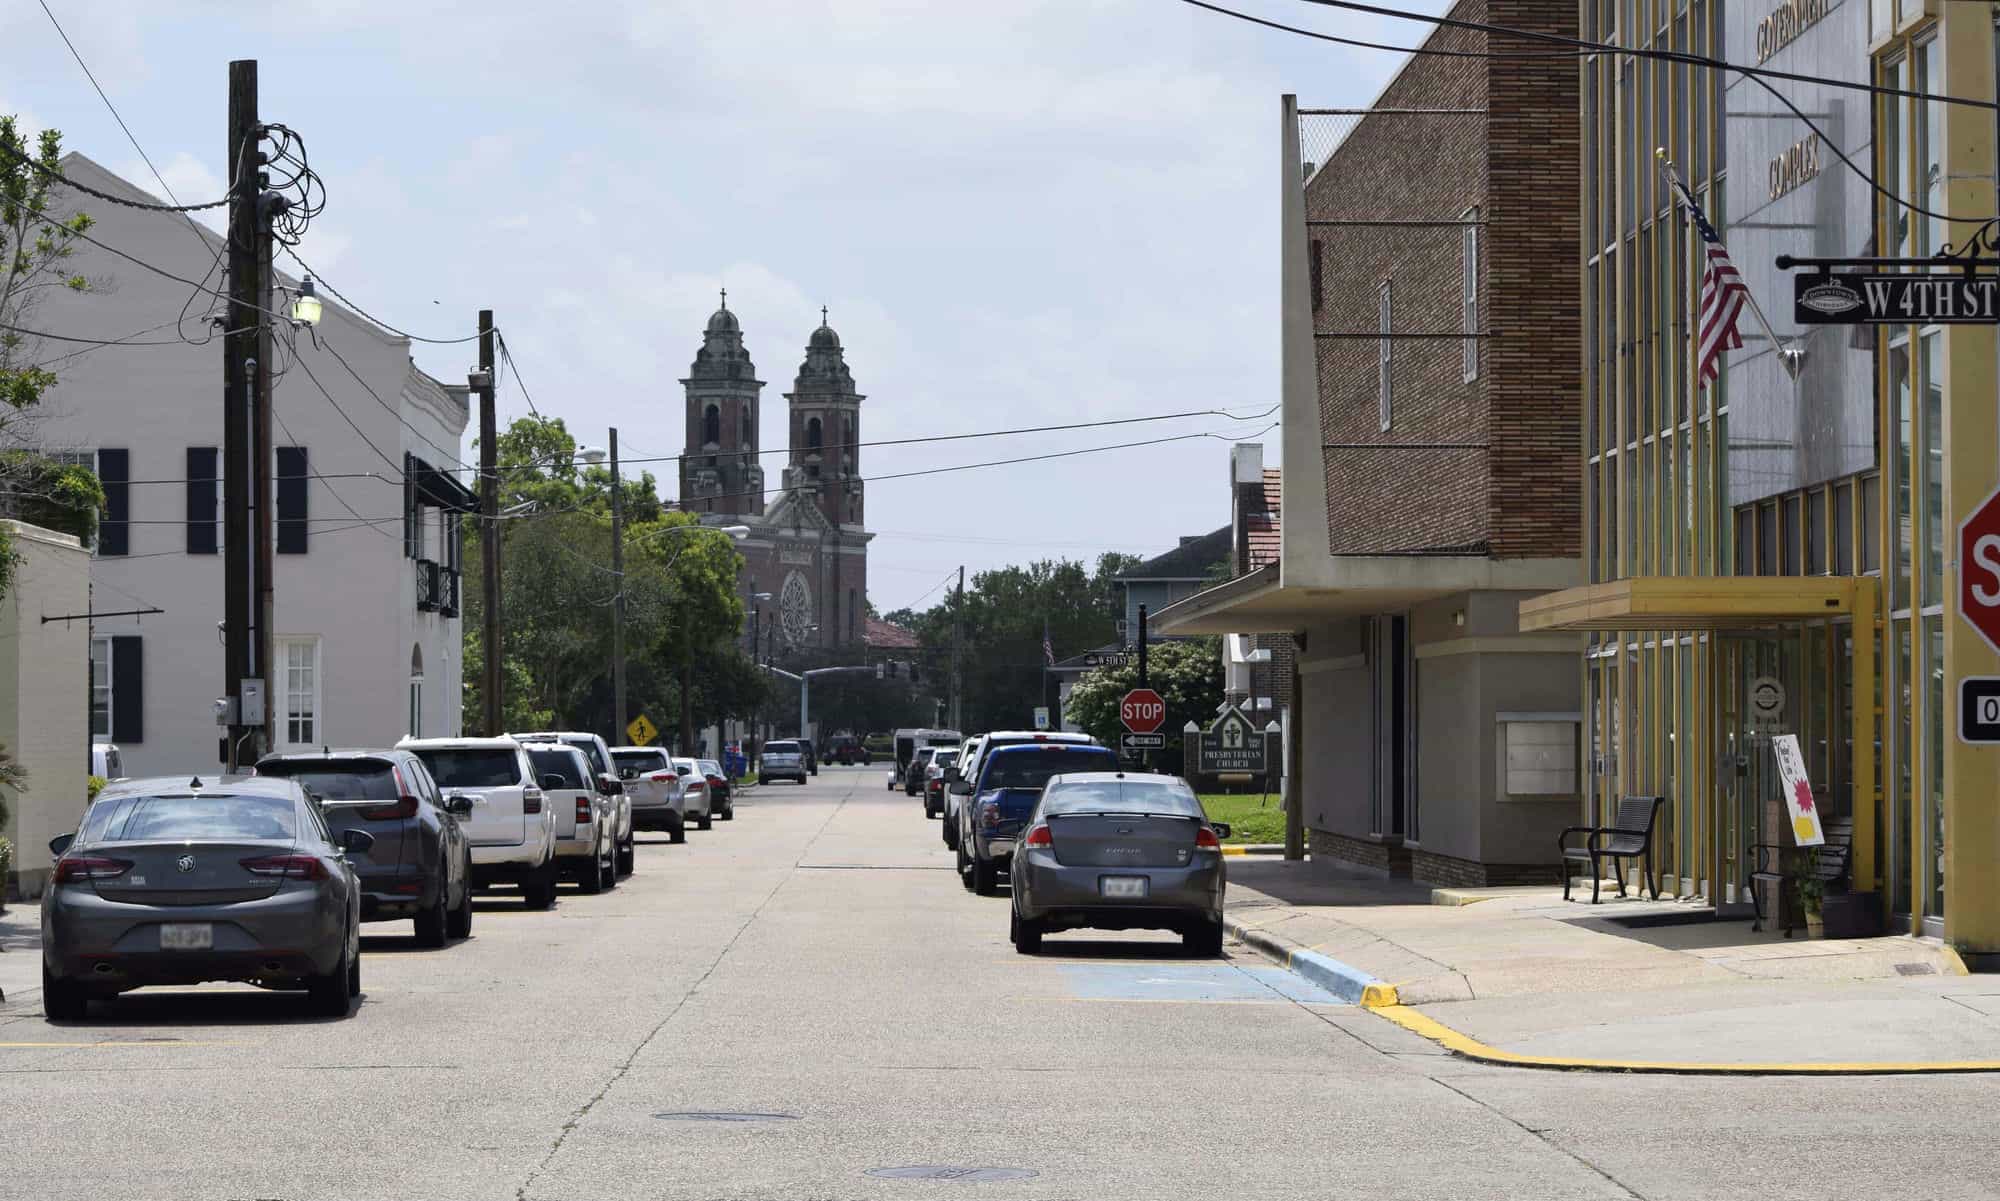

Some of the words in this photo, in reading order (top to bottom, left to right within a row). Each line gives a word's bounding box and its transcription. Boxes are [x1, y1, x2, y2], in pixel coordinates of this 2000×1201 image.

[1769, 133, 1820, 201] COMPLEX
[1863, 281, 1892, 317] W
[1899, 281, 1954, 317] 4TH
[1962, 281, 1997, 317] ST
[1123, 703, 1162, 720] STOP
[1204, 751, 1262, 759] PRESBYTERIAN
[1216, 759, 1249, 768] CHURCH
